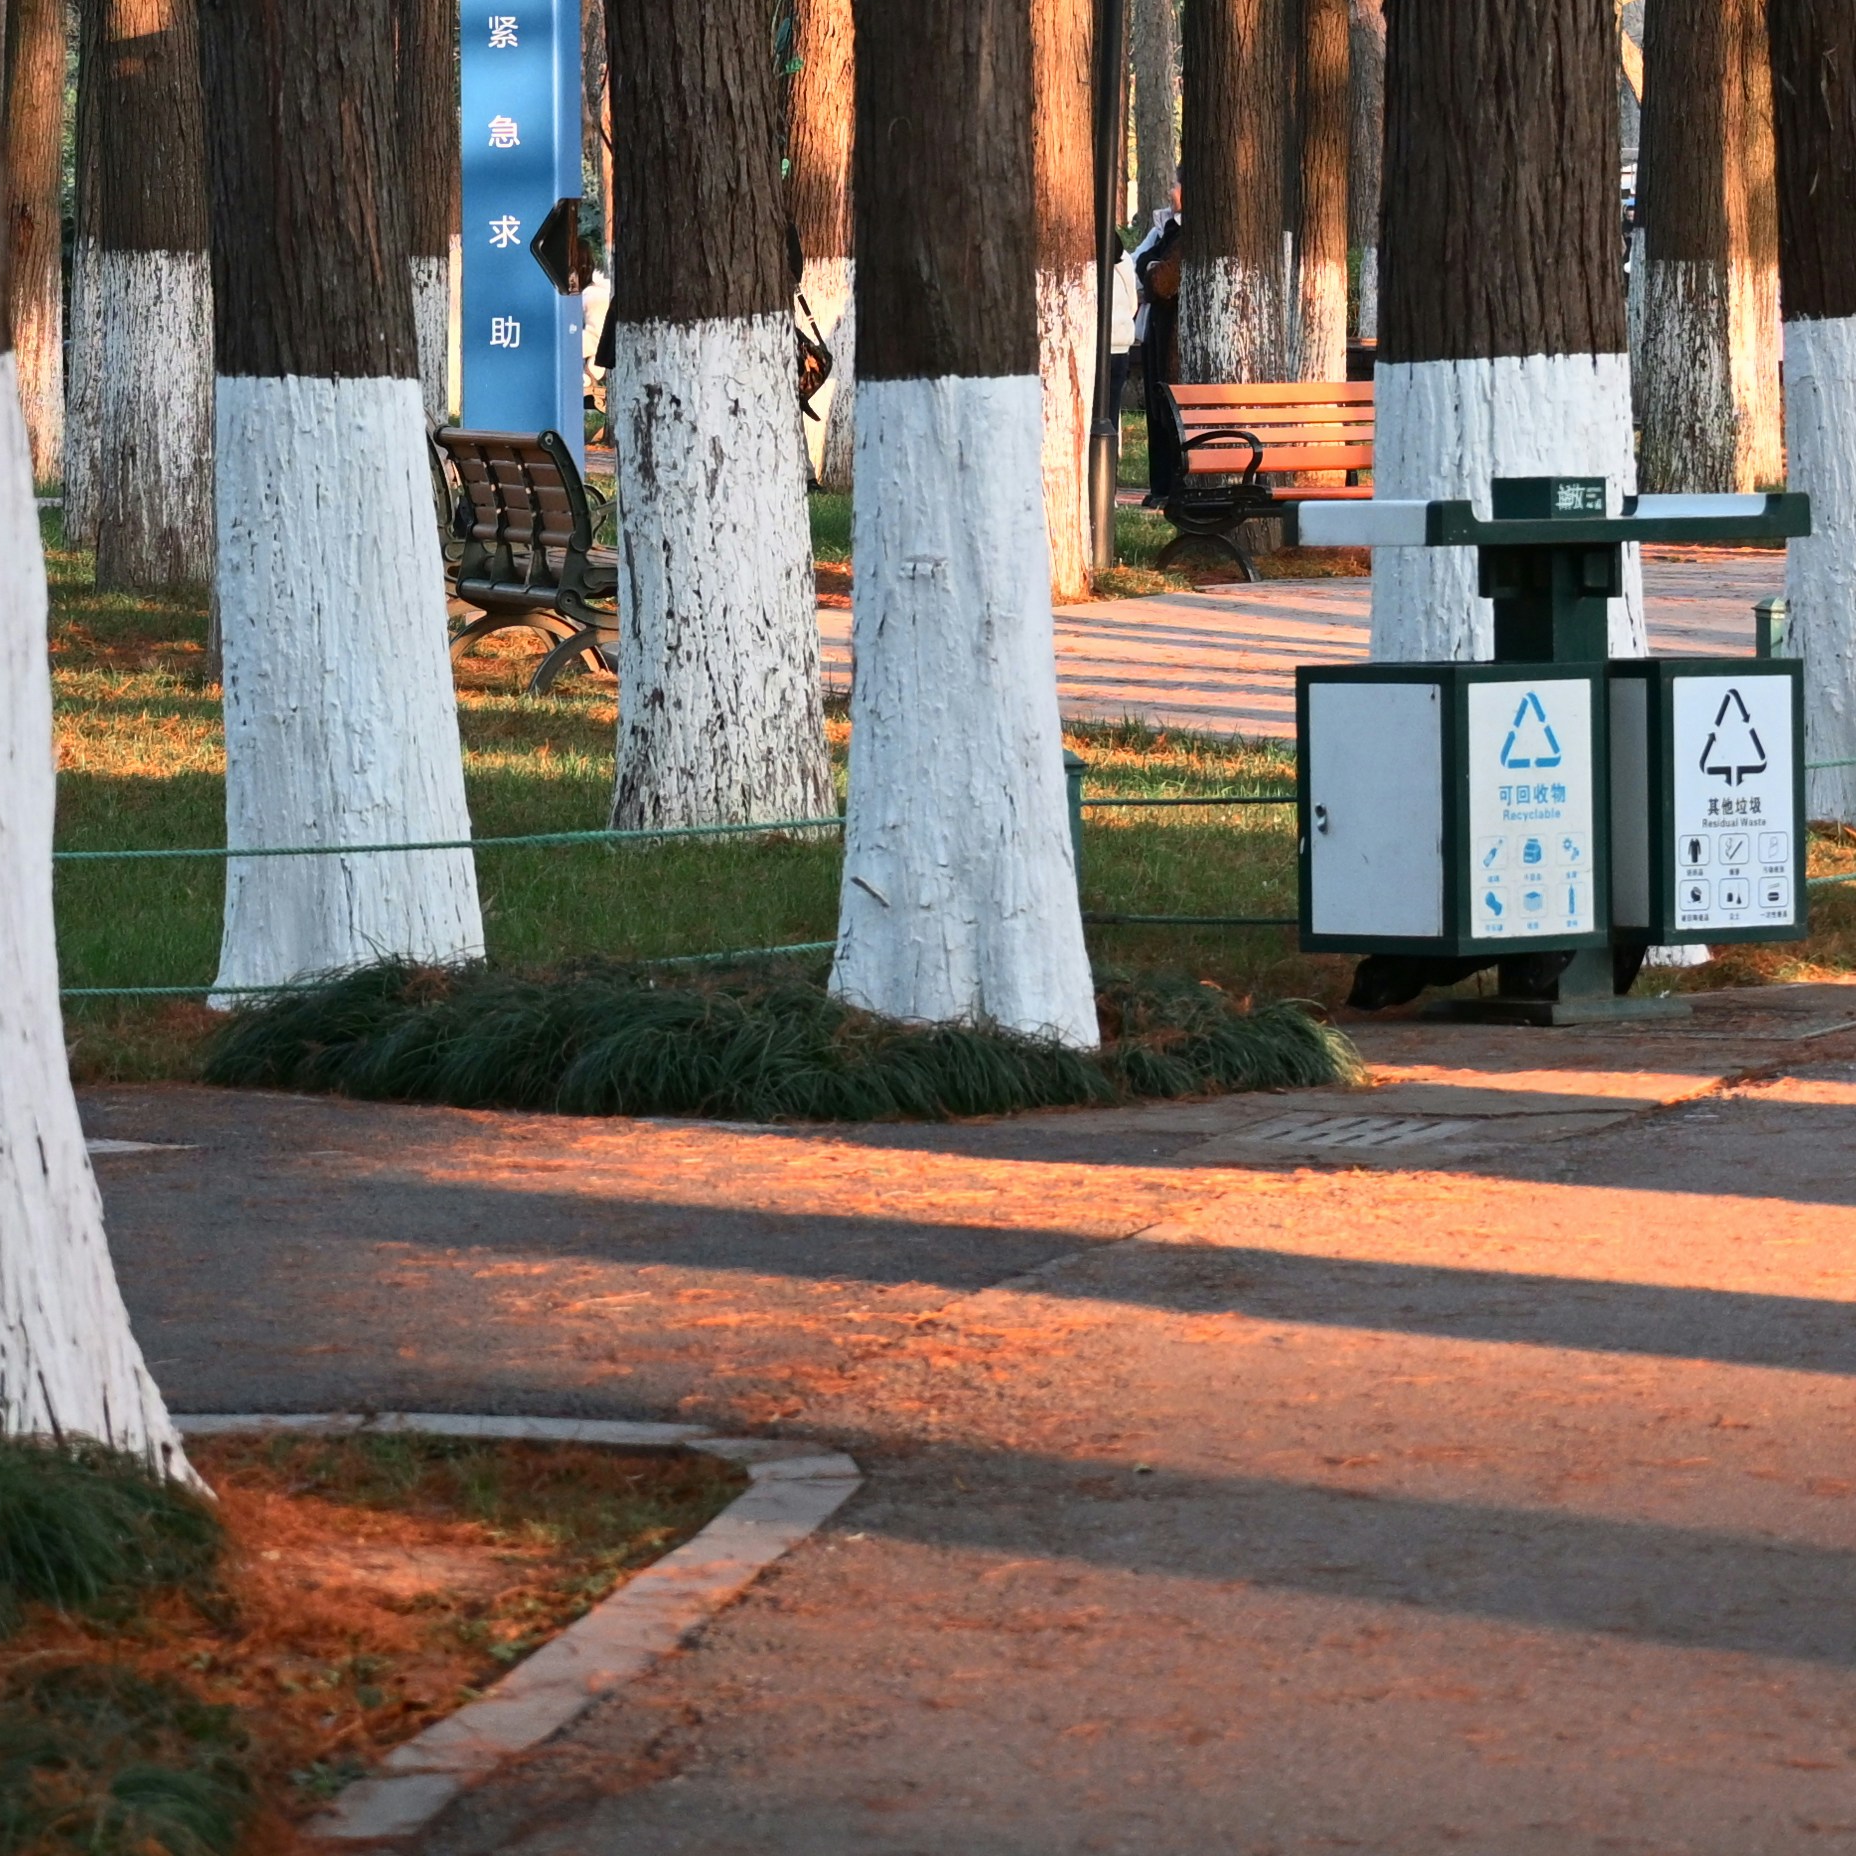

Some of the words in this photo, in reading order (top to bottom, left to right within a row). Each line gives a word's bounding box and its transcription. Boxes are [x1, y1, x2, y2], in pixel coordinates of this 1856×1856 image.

[487, 15, 521, 349] 紧急求助
[1498, 782, 1566, 806] 可回收物
[1502, 808, 1562, 822] Recyclable
[1707, 796, 1762, 816] 其他垃圾
[1701, 817, 1739, 828] Residual
[1740, 817, 1767, 827] Waste
